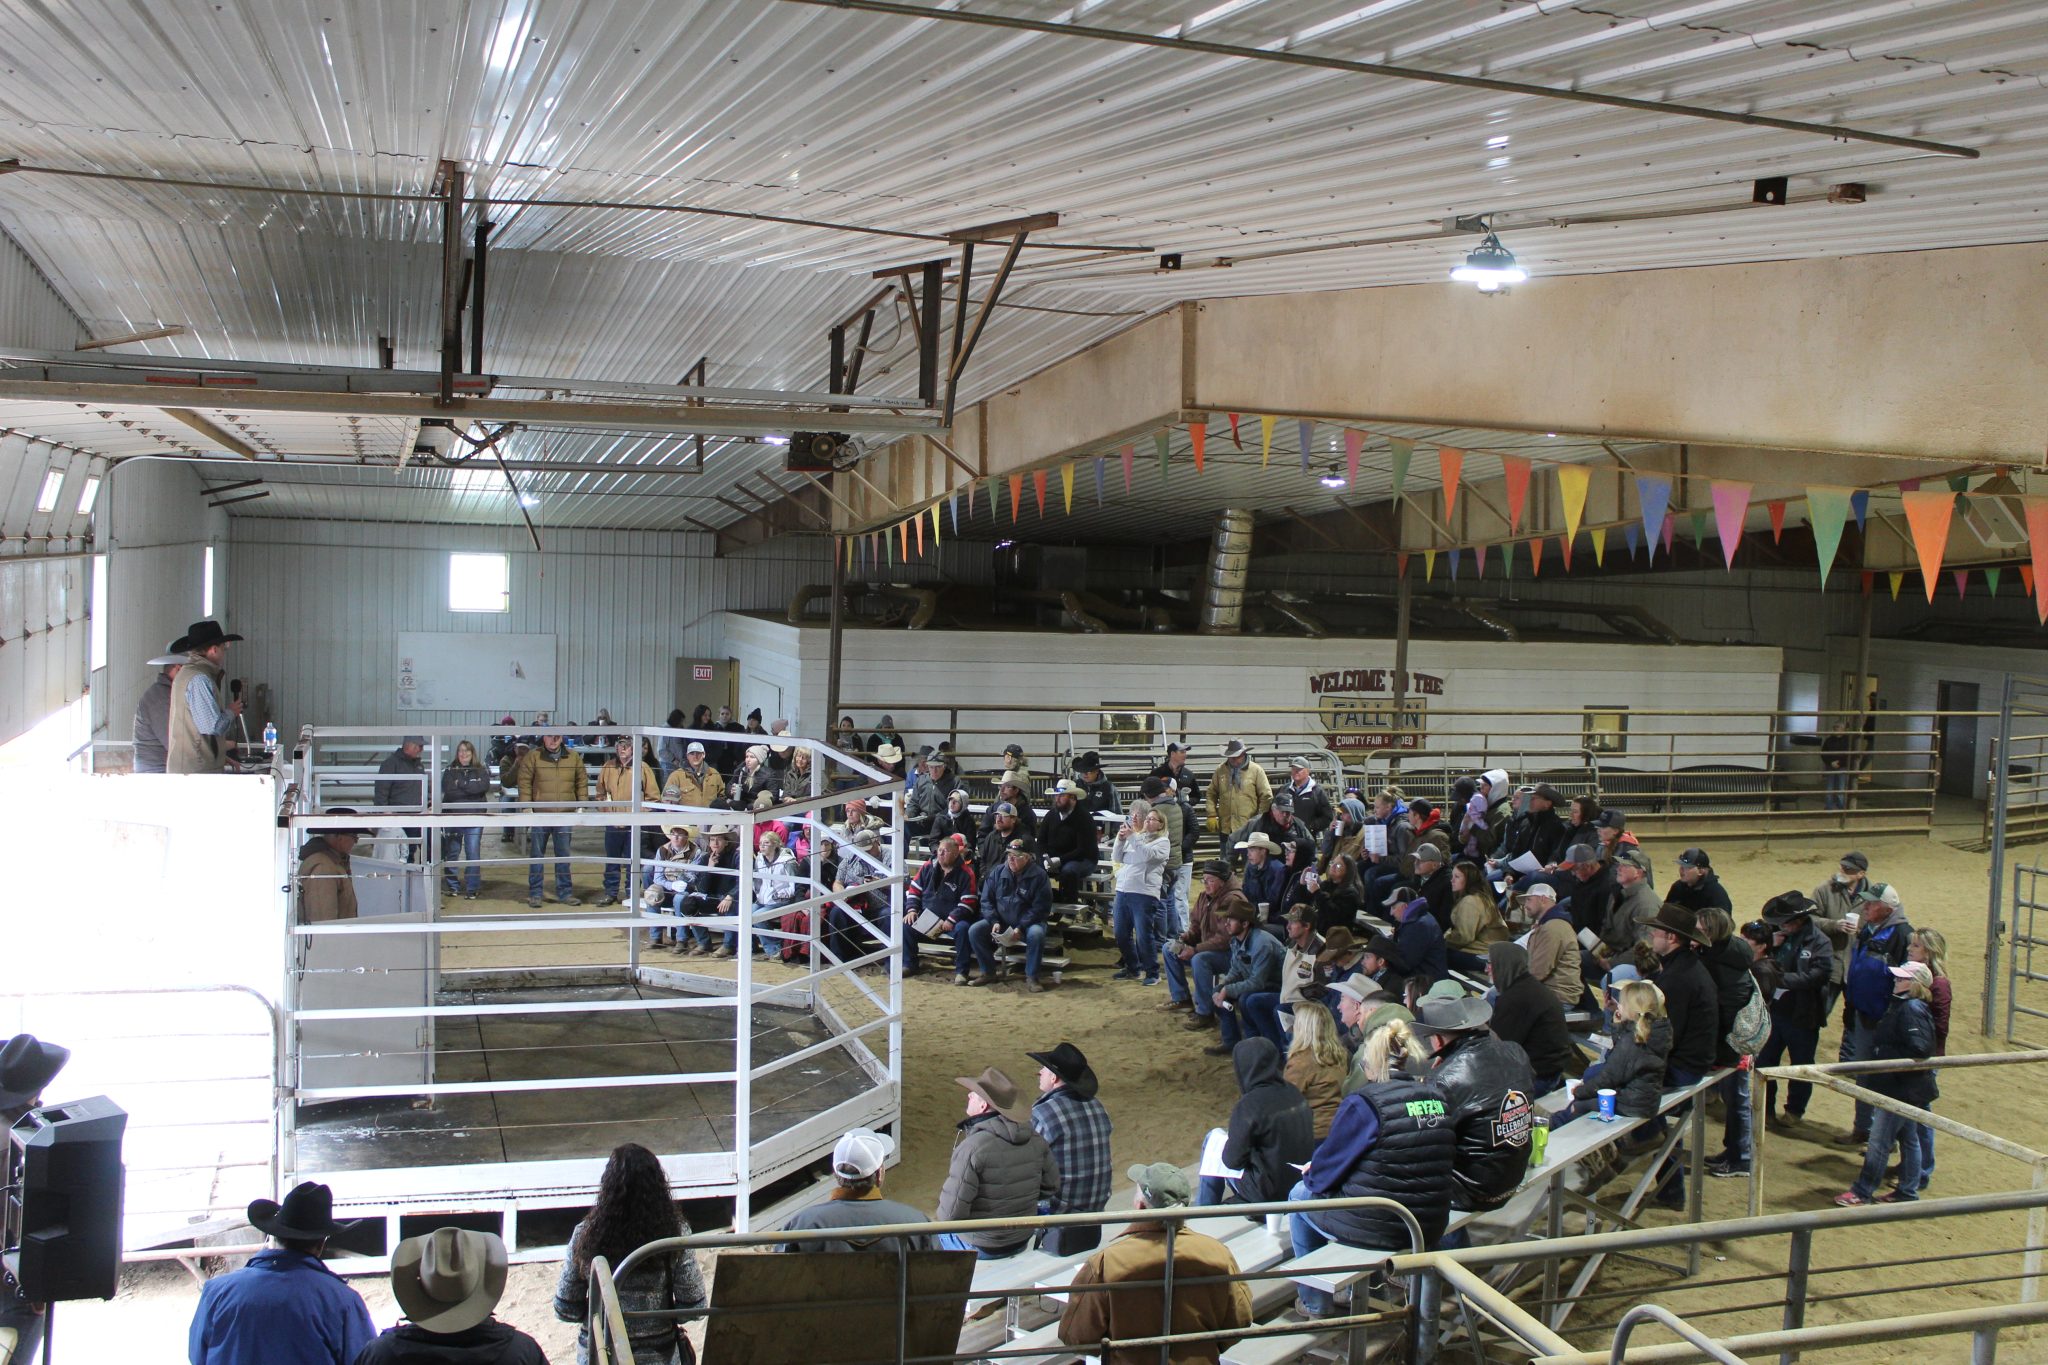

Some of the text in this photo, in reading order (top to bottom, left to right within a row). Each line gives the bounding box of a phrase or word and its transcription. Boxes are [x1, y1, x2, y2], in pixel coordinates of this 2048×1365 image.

[695, 668, 711, 678] EXIT
[1310, 669, 1386, 694] WELCOME
[1413, 672, 1444, 695] THE
[1336, 735, 1366, 746] COUNTY
[1366, 735, 1382, 745] FAIR
